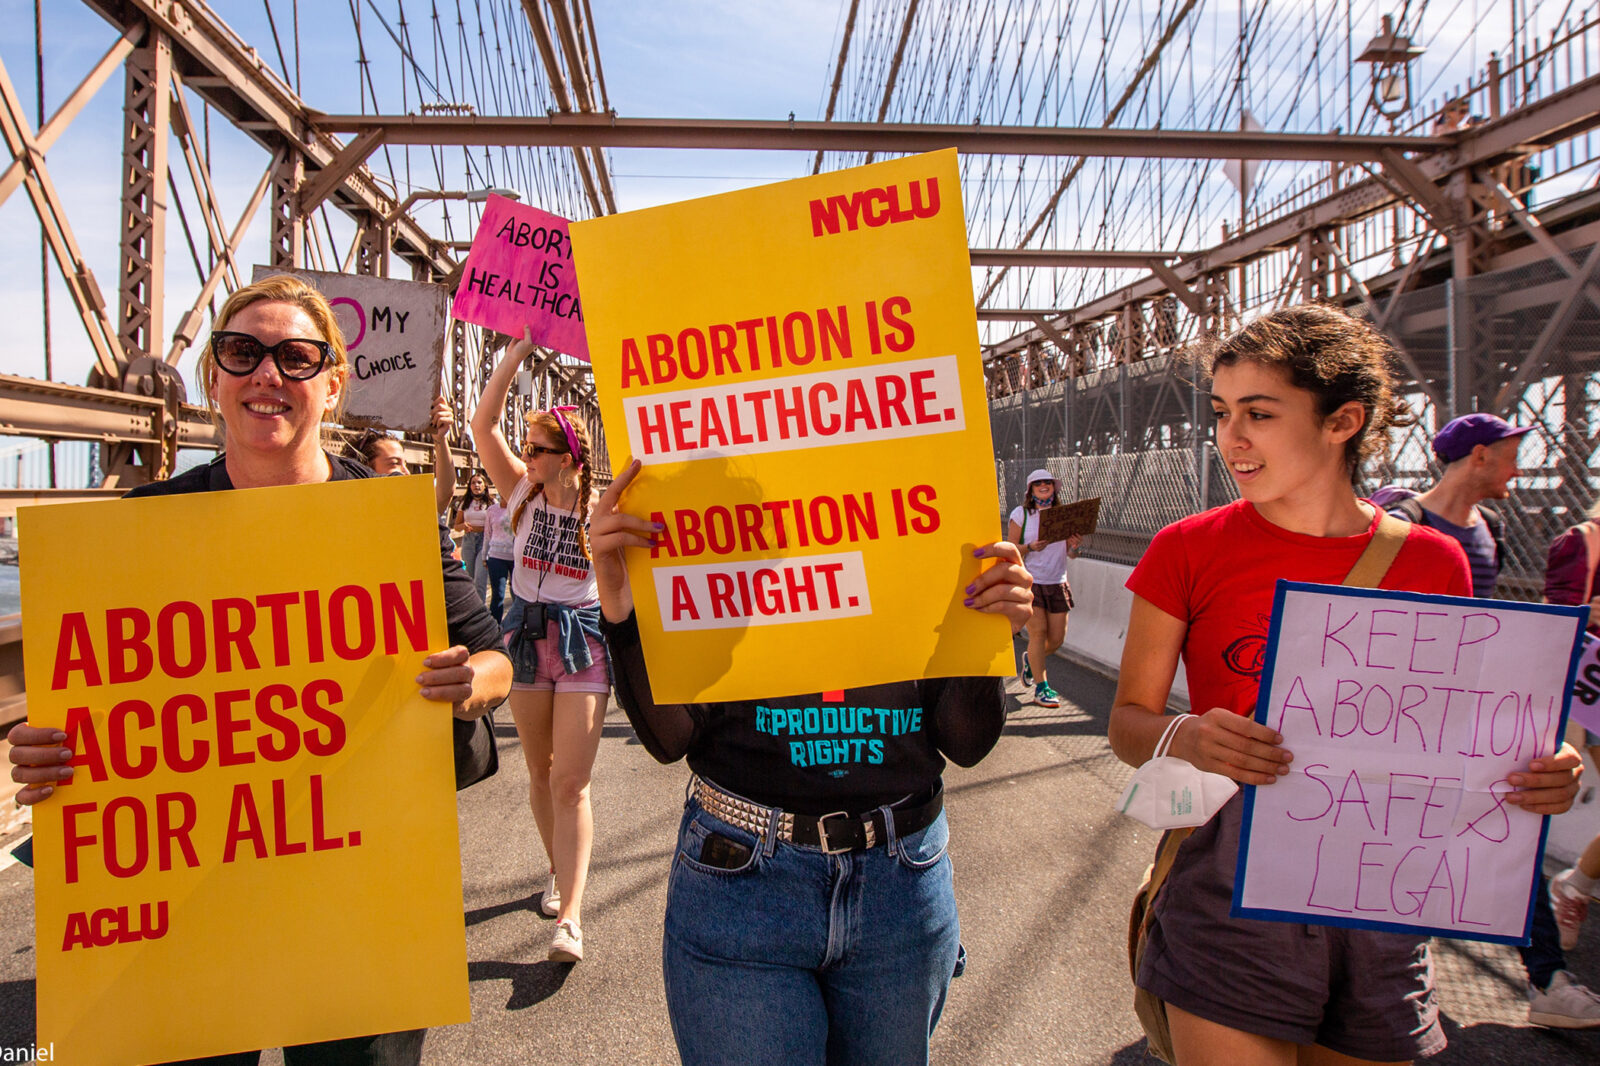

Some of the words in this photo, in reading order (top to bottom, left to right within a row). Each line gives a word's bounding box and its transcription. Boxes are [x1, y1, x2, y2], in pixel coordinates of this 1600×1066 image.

[809, 177, 941, 238] NYCLU
[467, 267, 584, 322] HEALTHCA
[538, 261, 563, 289] IS
[371, 306, 409, 333] MY
[621, 305, 853, 389] ABORTION
[865, 296, 915, 355] IS
[354, 351, 417, 380] CHOICE
[637, 369, 956, 455] HEALTHCARE.
[526, 532, 556, 552] FUNNY
[533, 508, 556, 527] BOLD
[650, 491, 880, 559] ABORTION
[891, 484, 941, 537] IS
[522, 556, 553, 573] PRETTY
[554, 563, 589, 581] WOMAN
[523, 544, 555, 563] STRONG
[557, 554, 590, 570] WOMAN
[672, 575, 701, 621] A
[706, 562, 860, 619] RIGHT.
[51, 579, 430, 691] ABORTION
[1320, 602, 1502, 677] KEEP
[1573, 647, 1600, 706] UR
[56, 678, 347, 786] ACCESS
[1276, 674, 1555, 762] ABORTION
[788, 738, 885, 768] RIGHTS
[62, 791, 201, 885] FOR
[222, 774, 363, 864] ALL.
[1286, 763, 1462, 840] SAFE
[1306, 834, 1492, 927] LEGAL
[61, 900, 169, 952] ACLU
